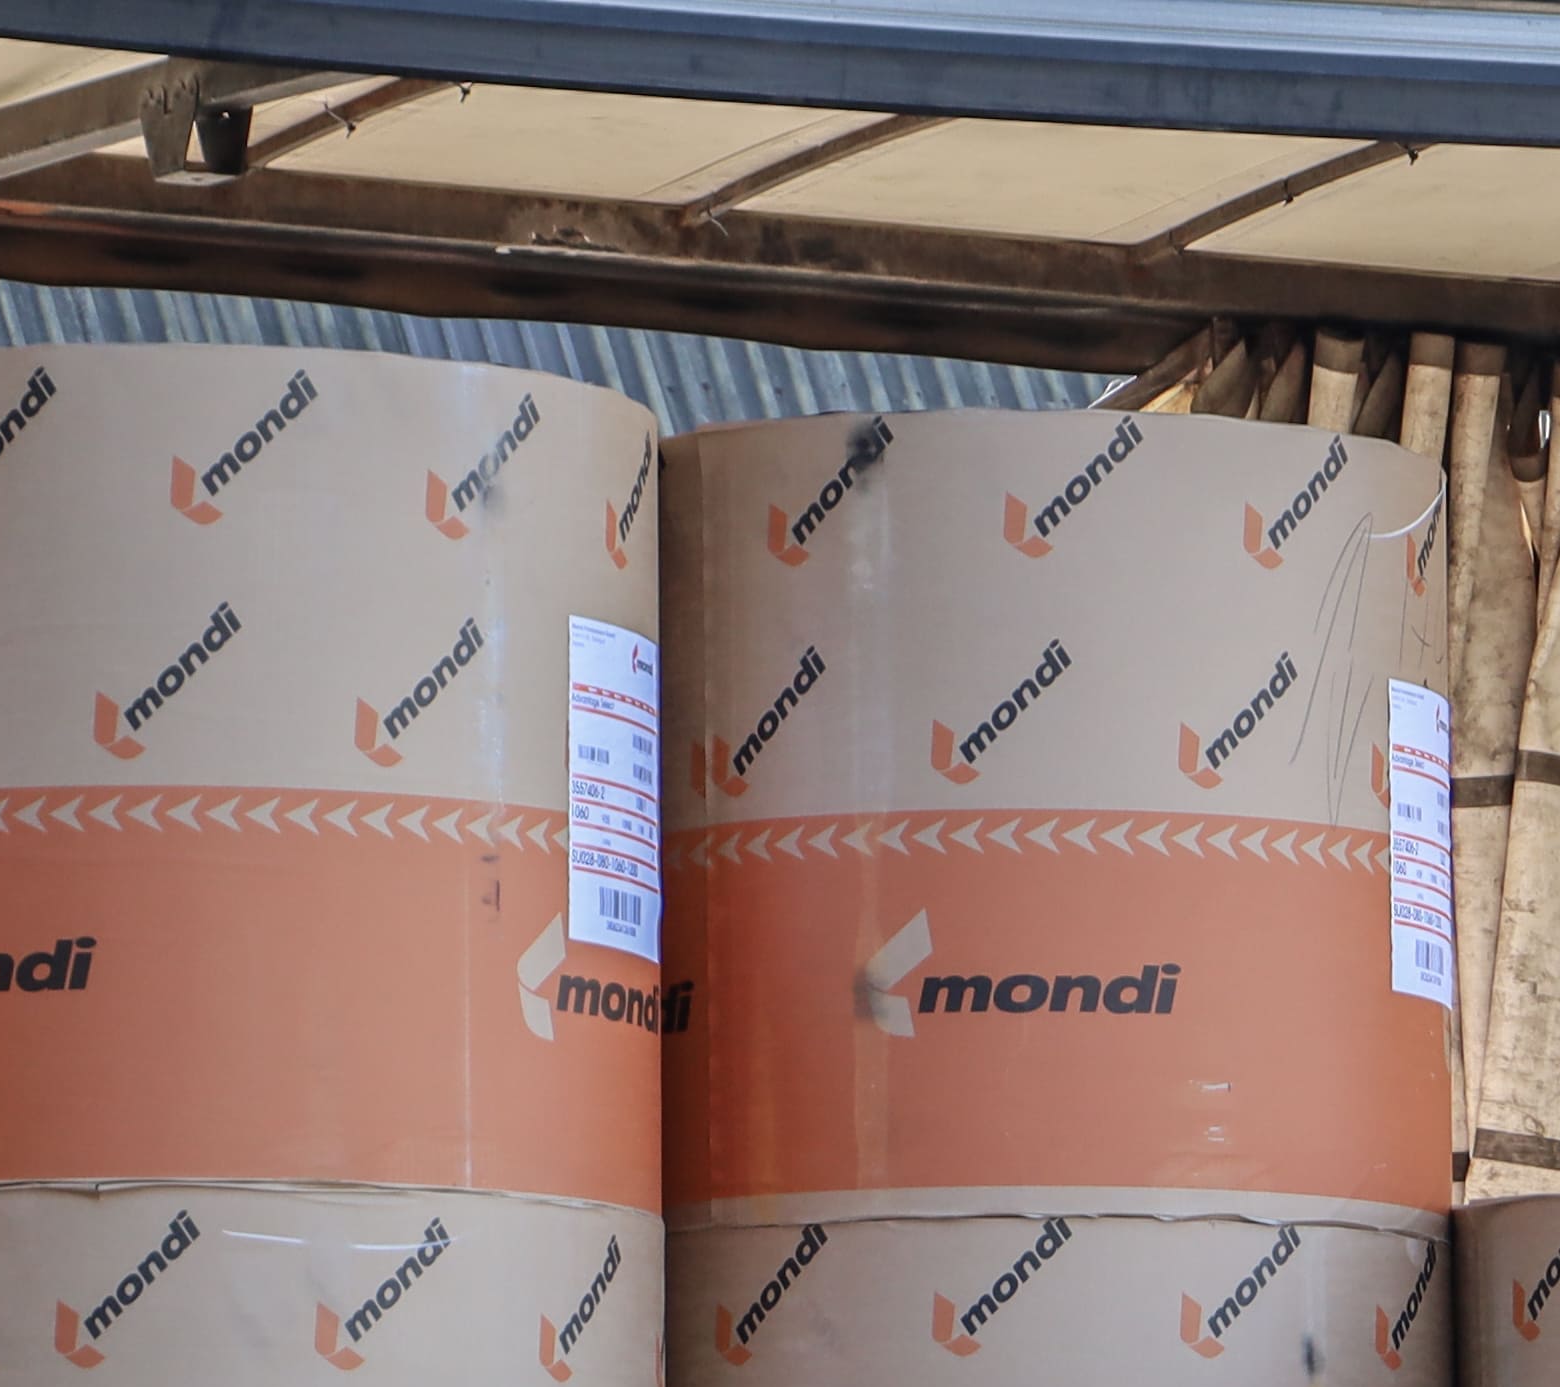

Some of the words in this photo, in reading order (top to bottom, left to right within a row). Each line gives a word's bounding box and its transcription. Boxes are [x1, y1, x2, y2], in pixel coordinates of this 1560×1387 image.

[202, 370, 317, 496] mondi
[452, 394, 540, 512] mondi
[1034, 416, 1142, 537] mondi
[1269, 435, 1347, 549] mondi
[124, 602, 241, 731] mondi
[384, 618, 483, 739] mondi
[733, 646, 826, 776] mondi
[960, 640, 1071, 764] mondi
[1206, 652, 1297, 769] mondi
[571, 803, 589, 820] 1060
[918, 965, 1180, 1014] mondi
[84, 1211, 200, 1340] mondi
[345, 1218, 448, 1342] mondi
[560, 1235, 621, 1354] mondi
[736, 1223, 828, 1343] mondi
[960, 1217, 1073, 1336] mondi
[1207, 1224, 1302, 1338] mondi
